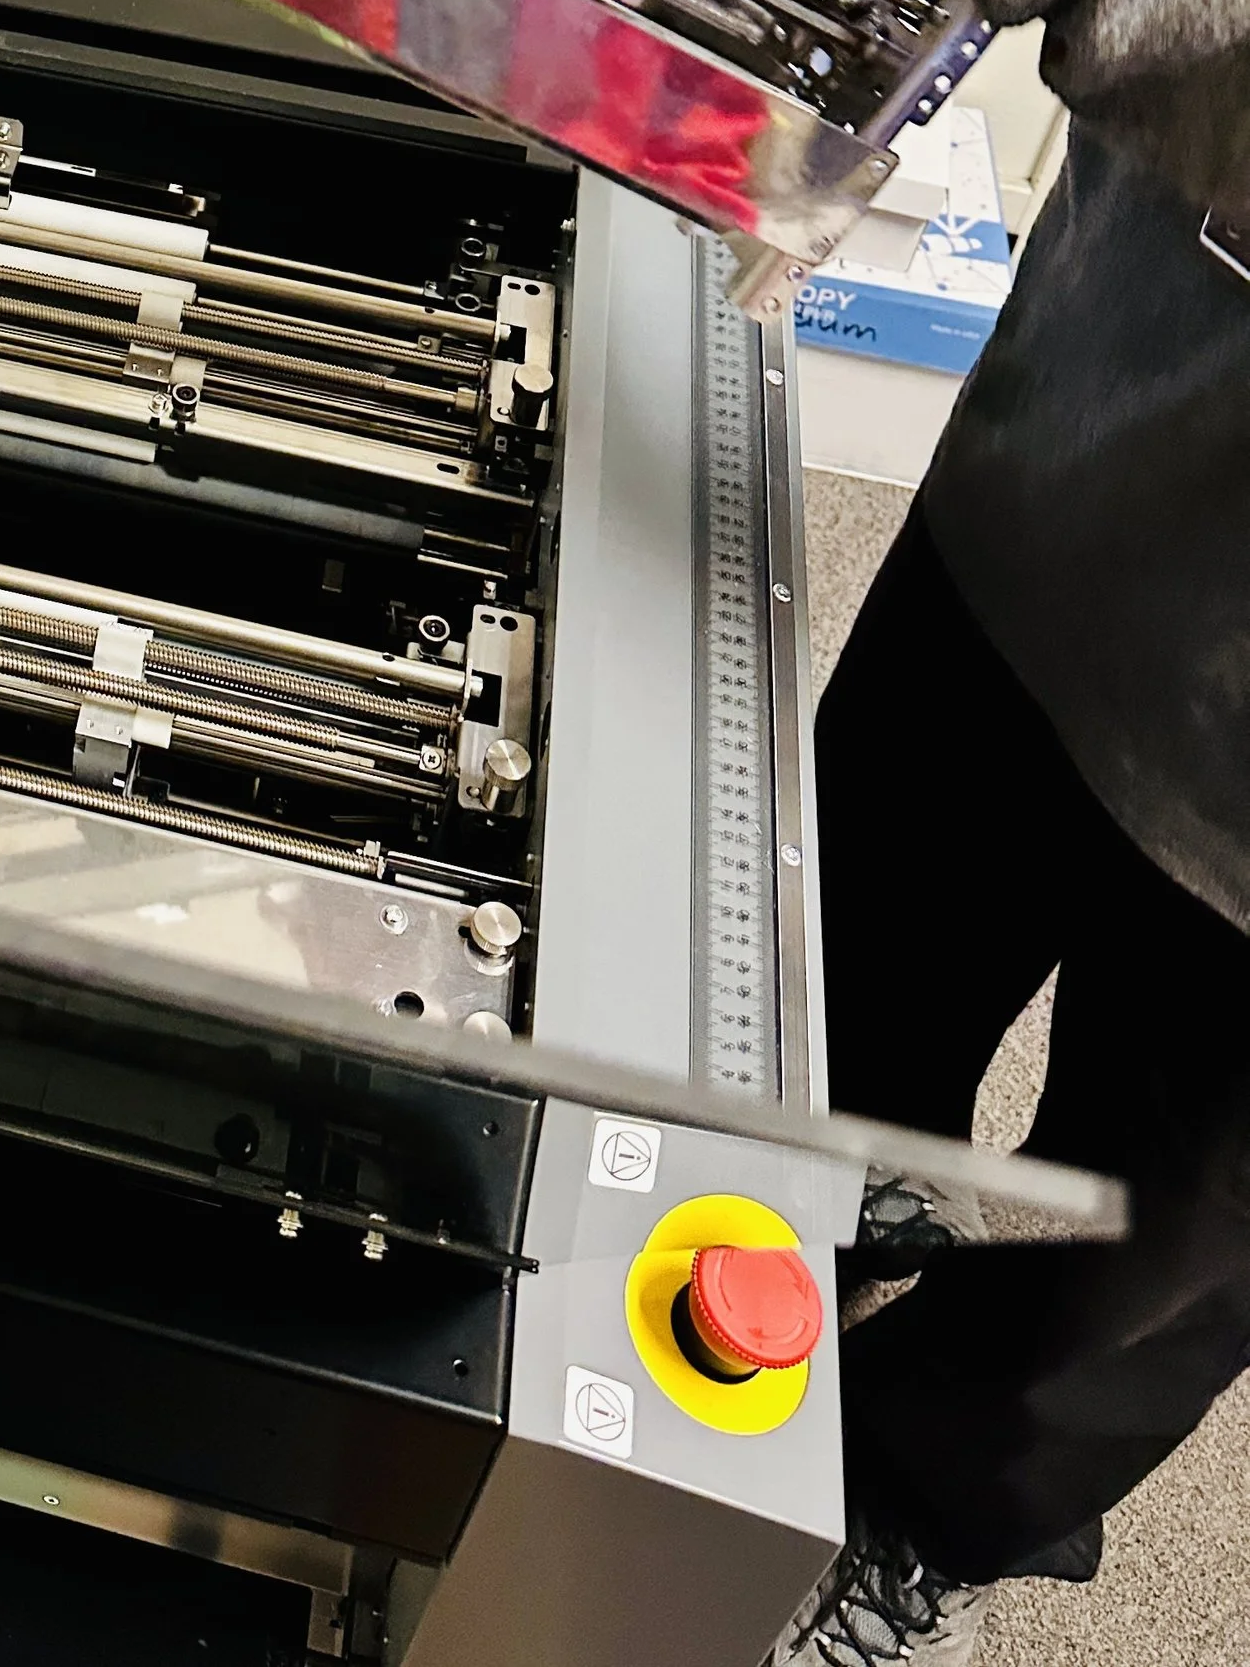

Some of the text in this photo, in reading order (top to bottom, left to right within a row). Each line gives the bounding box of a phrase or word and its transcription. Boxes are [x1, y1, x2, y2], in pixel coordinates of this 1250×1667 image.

[797, 284, 857, 310] OPY
[721, 1014, 735, 1023] 6
[720, 1042, 735, 1052] 5
